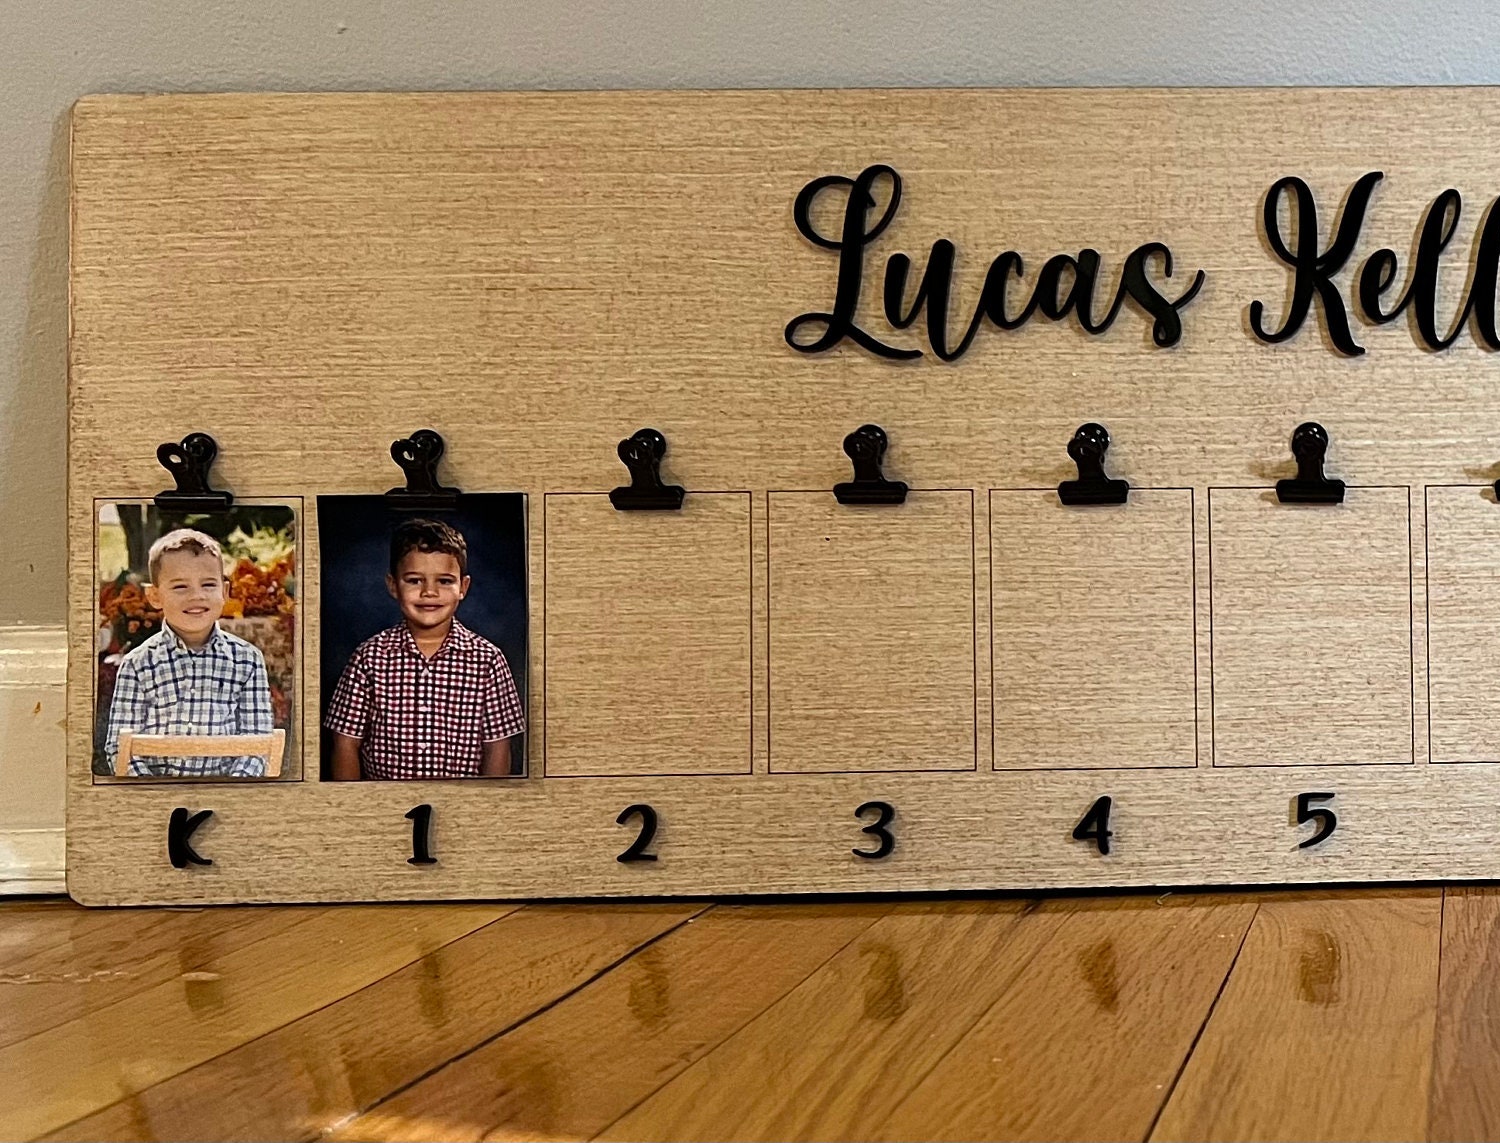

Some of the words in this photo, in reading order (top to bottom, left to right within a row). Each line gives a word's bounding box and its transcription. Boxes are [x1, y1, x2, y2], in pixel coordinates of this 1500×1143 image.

[784, 164, 1206, 363] Lucas
[167, 807, 214, 869] K
[403, 804, 438, 866] 1
[615, 804, 659, 864] 2
[852, 801, 896, 861] 3
[1072, 795, 1113, 856] 4
[1296, 791, 1337, 849] 5
